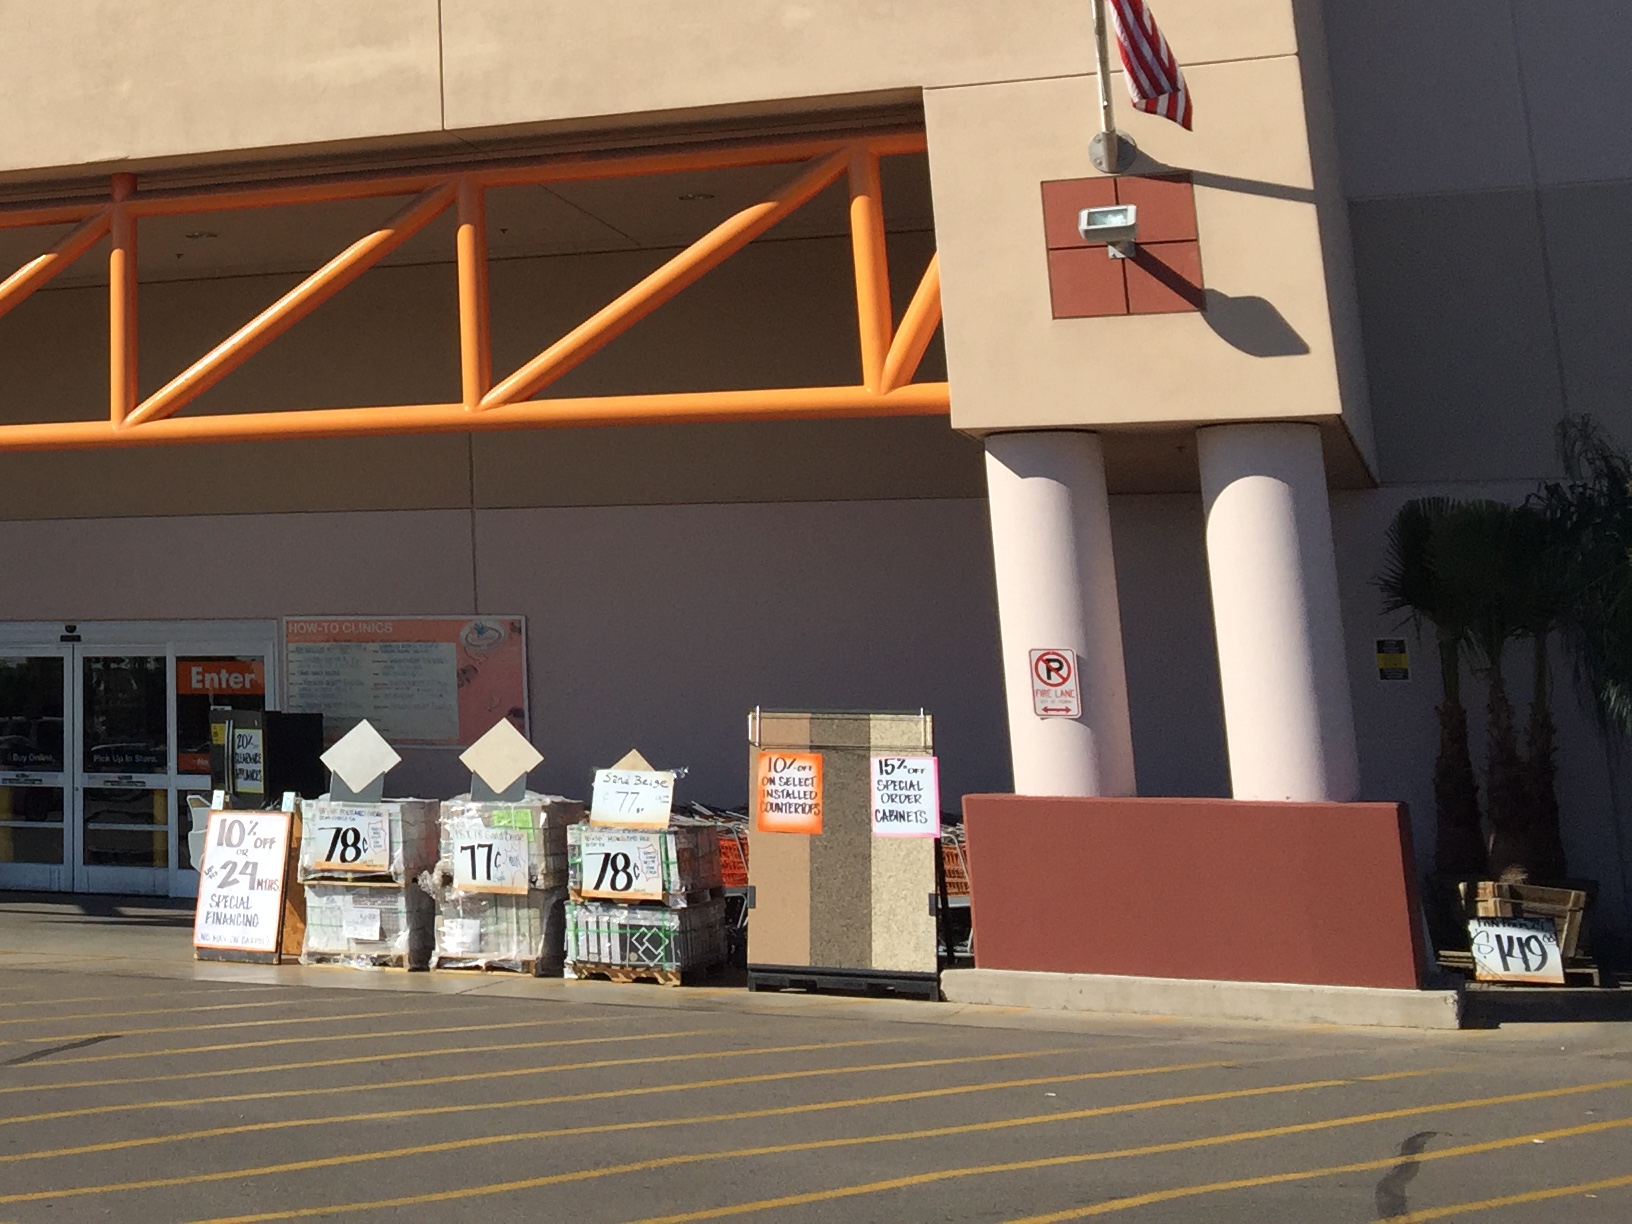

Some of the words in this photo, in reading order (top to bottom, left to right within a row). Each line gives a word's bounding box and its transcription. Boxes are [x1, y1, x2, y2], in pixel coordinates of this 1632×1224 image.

[288, 622, 339, 634] HOW-TO
[342, 622, 393, 634] CLINICS
[190, 666, 256, 689] Enter
[1035, 688, 1052, 698] FIRE
[1054, 689, 1075, 699] LANE
[879, 758, 908, 775] 15%
[761, 777, 776, 786] ON
[778, 777, 816, 787] SELECT
[876, 779, 923, 792] SPECIAL
[762, 788, 817, 800] INSTALLED
[880, 793, 922, 804] ORDER
[760, 801, 821, 815] COUNTERTOPS
[874, 809, 928, 824] CABINETS
[253, 837, 276, 850] OFF
[217, 860, 258, 891] 24
[209, 893, 252, 910] SPECIAL
[205, 911, 259, 927] FINANCING
